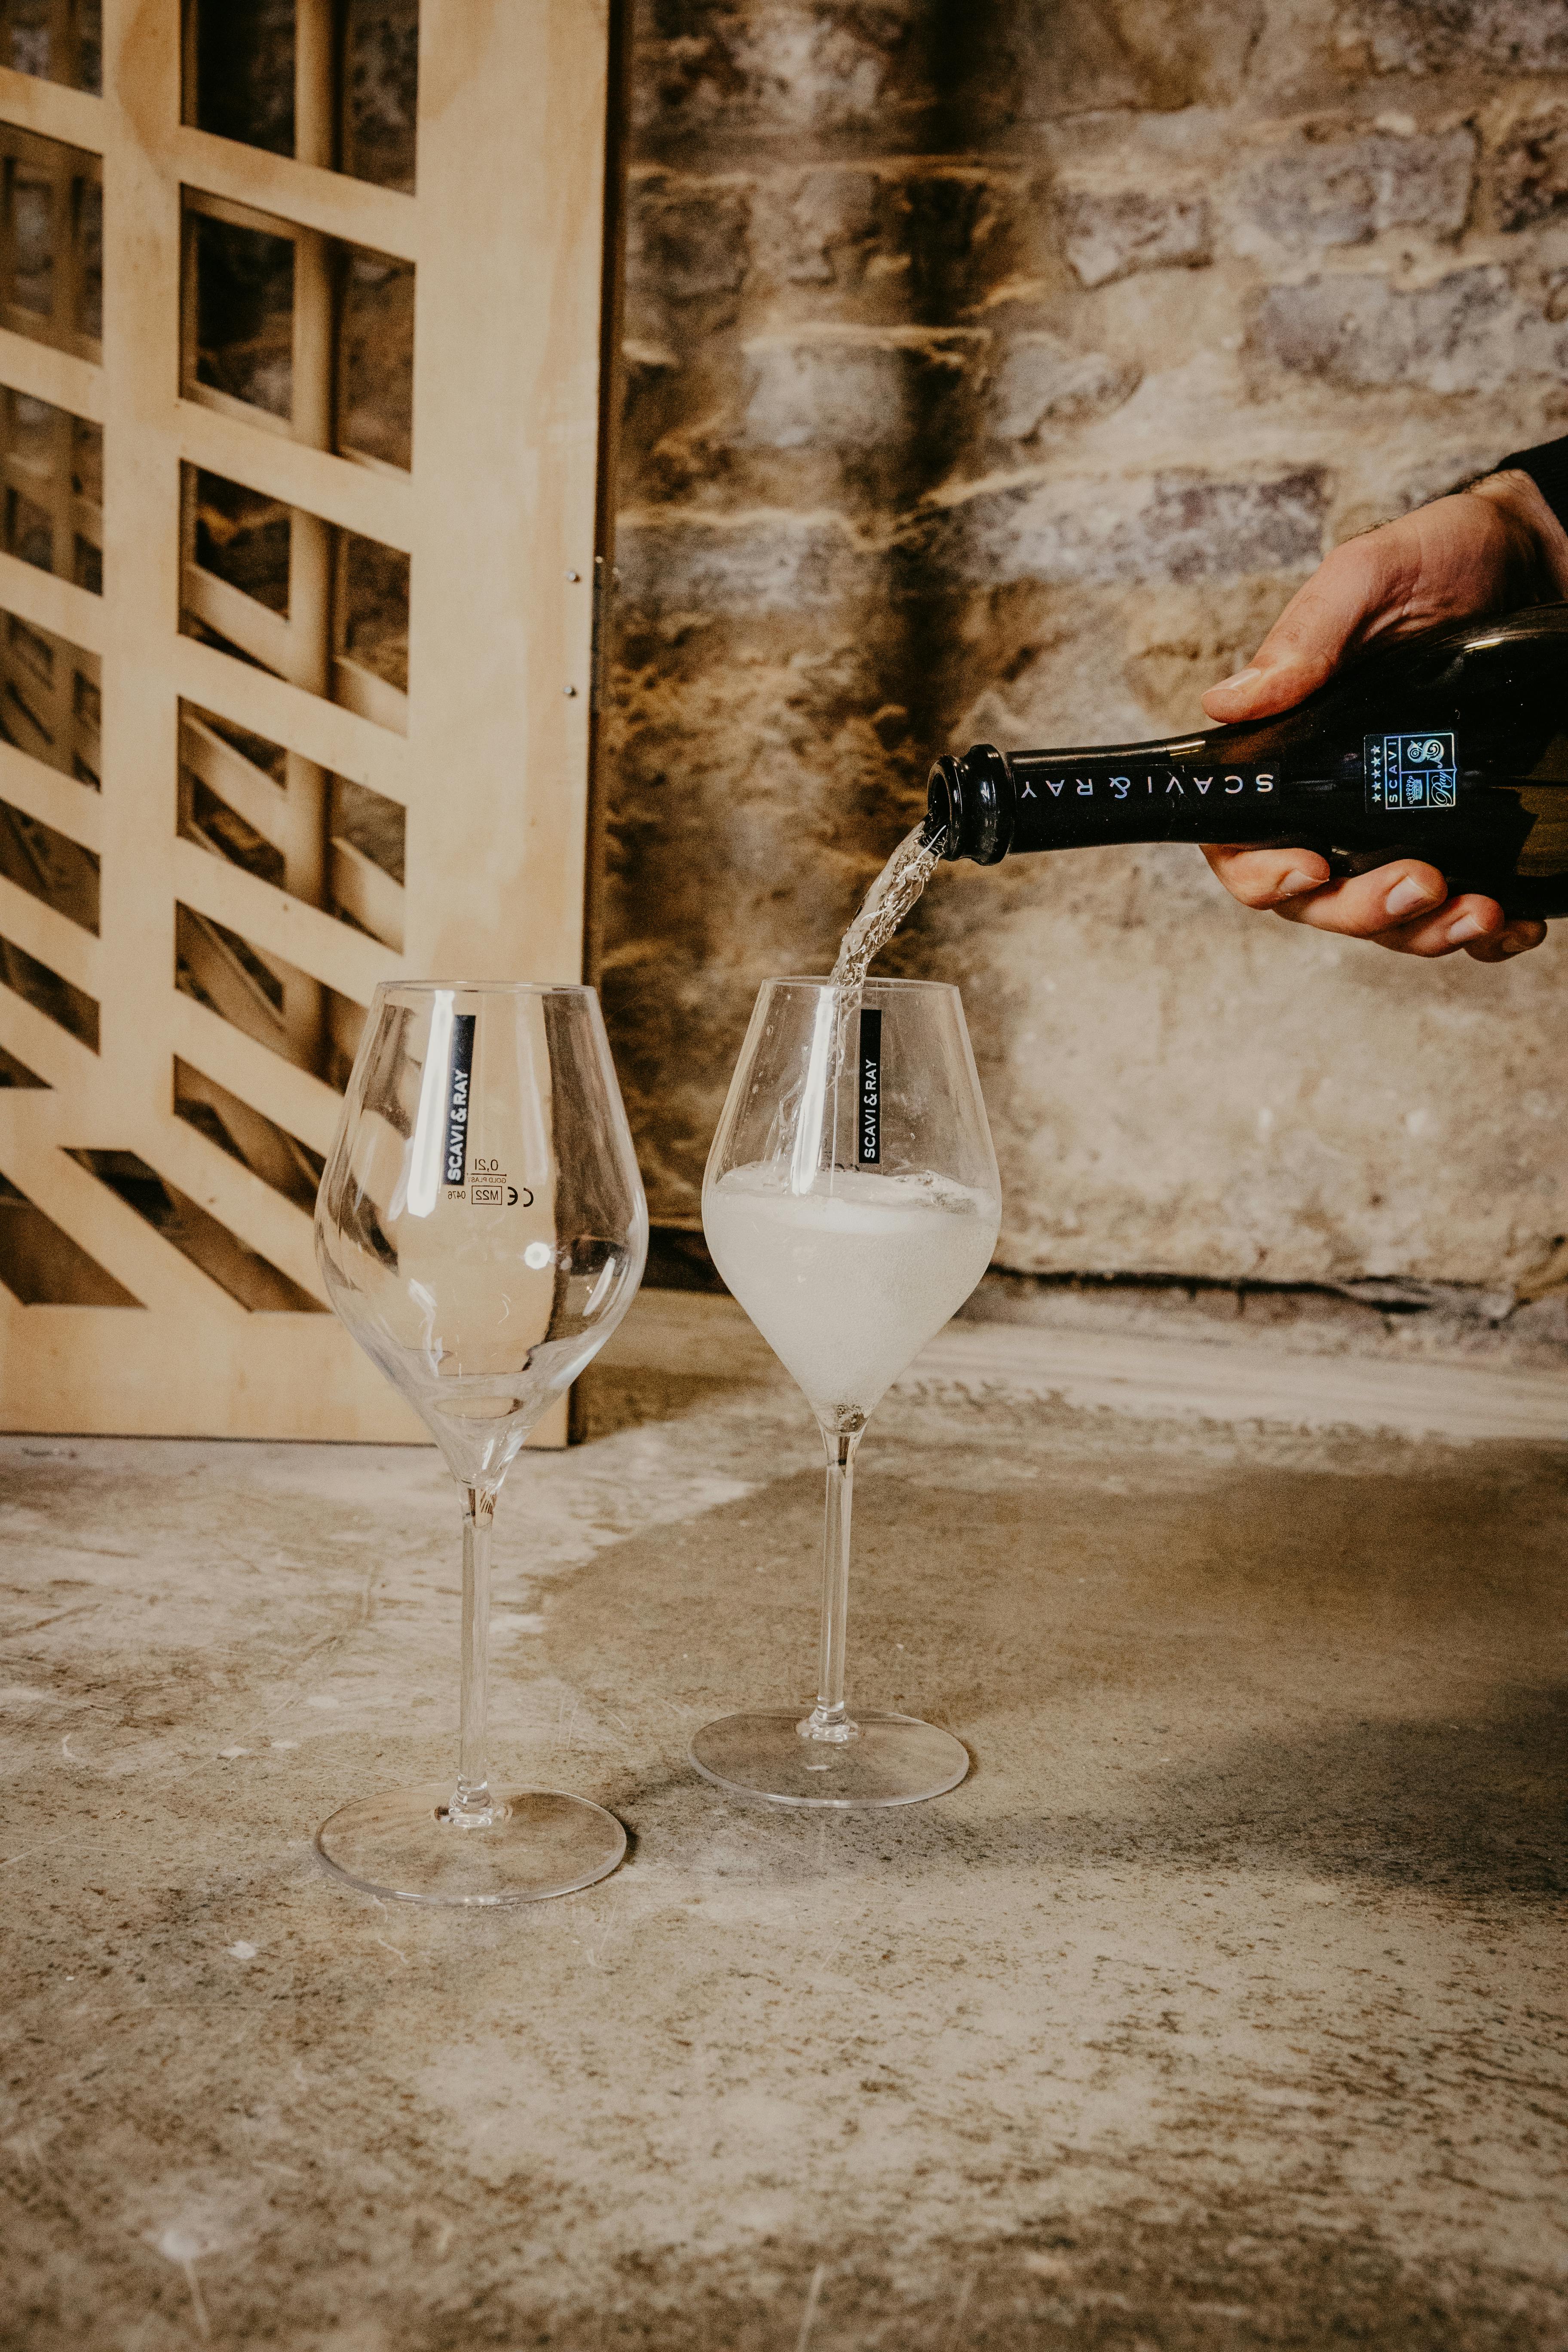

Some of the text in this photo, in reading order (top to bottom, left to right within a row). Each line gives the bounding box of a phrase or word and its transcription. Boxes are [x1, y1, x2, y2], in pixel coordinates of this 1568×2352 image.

[1021, 775, 1274, 798] SCAVI & RAY
[1388, 742, 1397, 802] SCAVI
[1431, 771, 1452, 805] Ray
[448, 1069, 468, 1181] SCAVI & RAY
[864, 1059, 877, 1158] SCAVI & RAY
